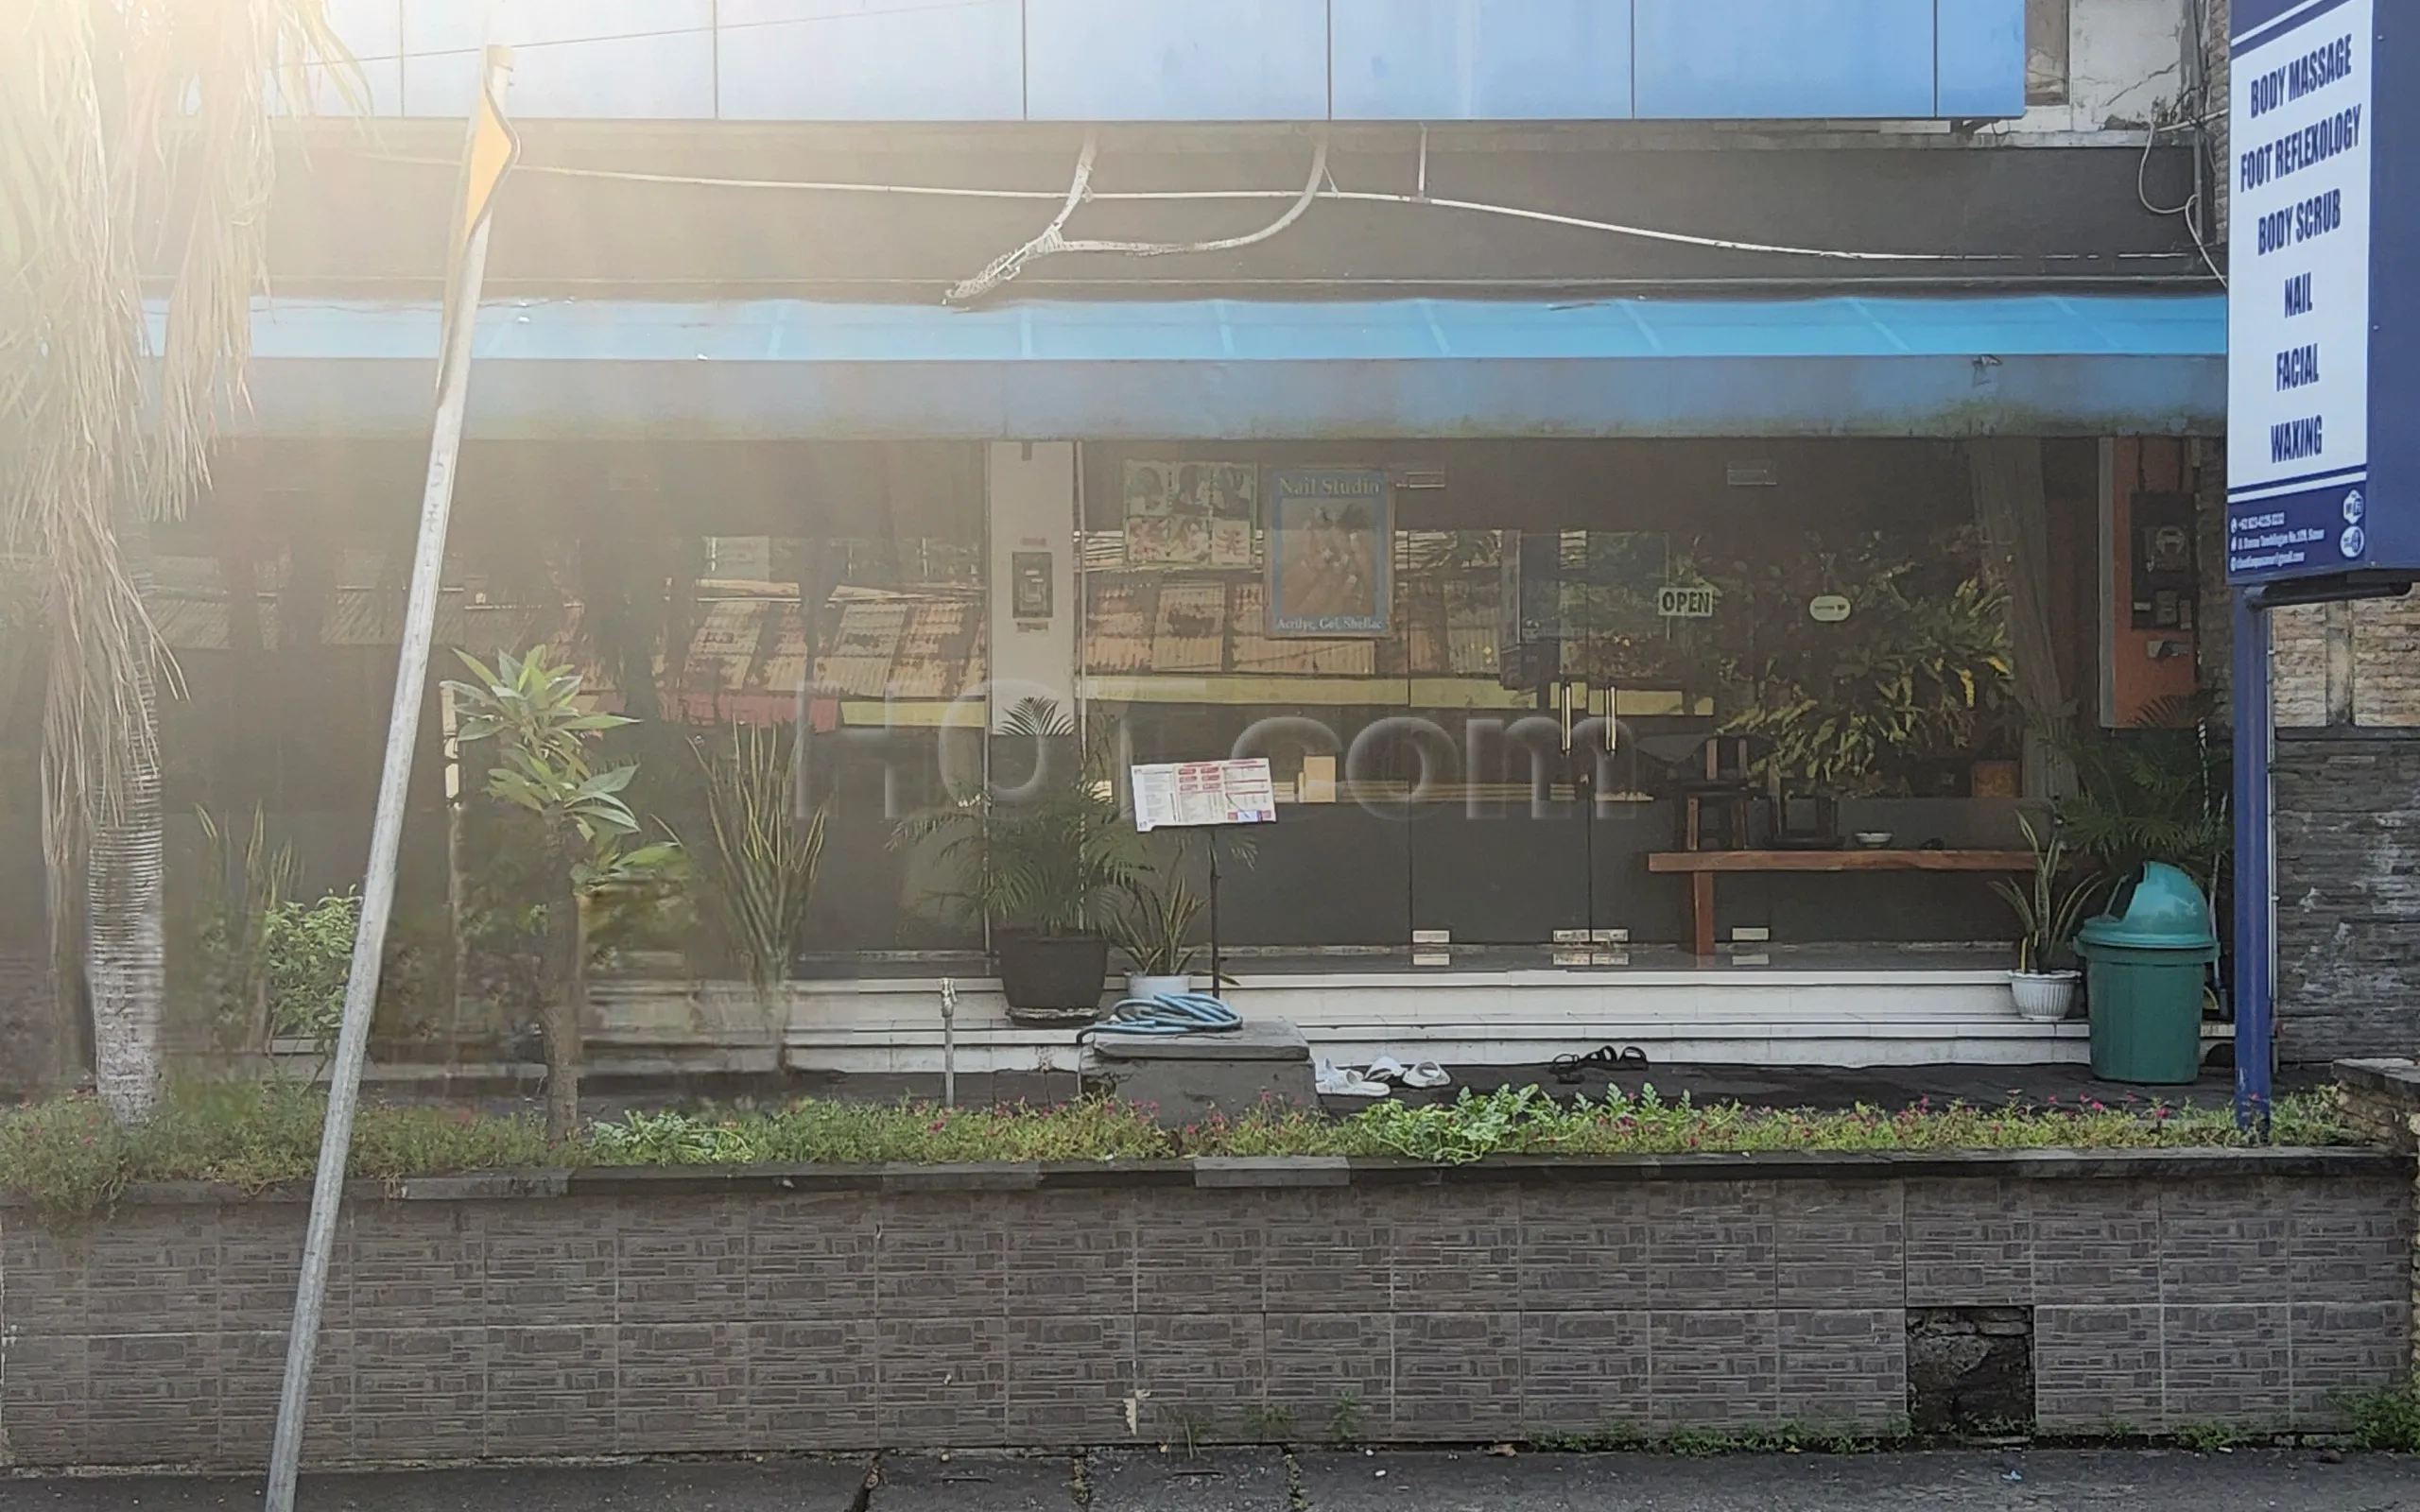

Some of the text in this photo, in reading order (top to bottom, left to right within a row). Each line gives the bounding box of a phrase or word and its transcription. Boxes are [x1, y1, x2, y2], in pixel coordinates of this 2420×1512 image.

[2250, 33, 2352, 119] BODY MASSAGE
[2240, 103, 2362, 193] FOOT REFLEXOLOGY
[2257, 188, 2342, 256] BODY SCRUB
[2284, 272, 2313, 318] NAIL
[2275, 343, 2320, 392] FACIAL
[2271, 414, 2323, 463] WAXING
[1278, 476, 1380, 495] Nail Studio
[1343, 616, 1383, 629] Shellac
[1662, 591, 1710, 613] OPEN
